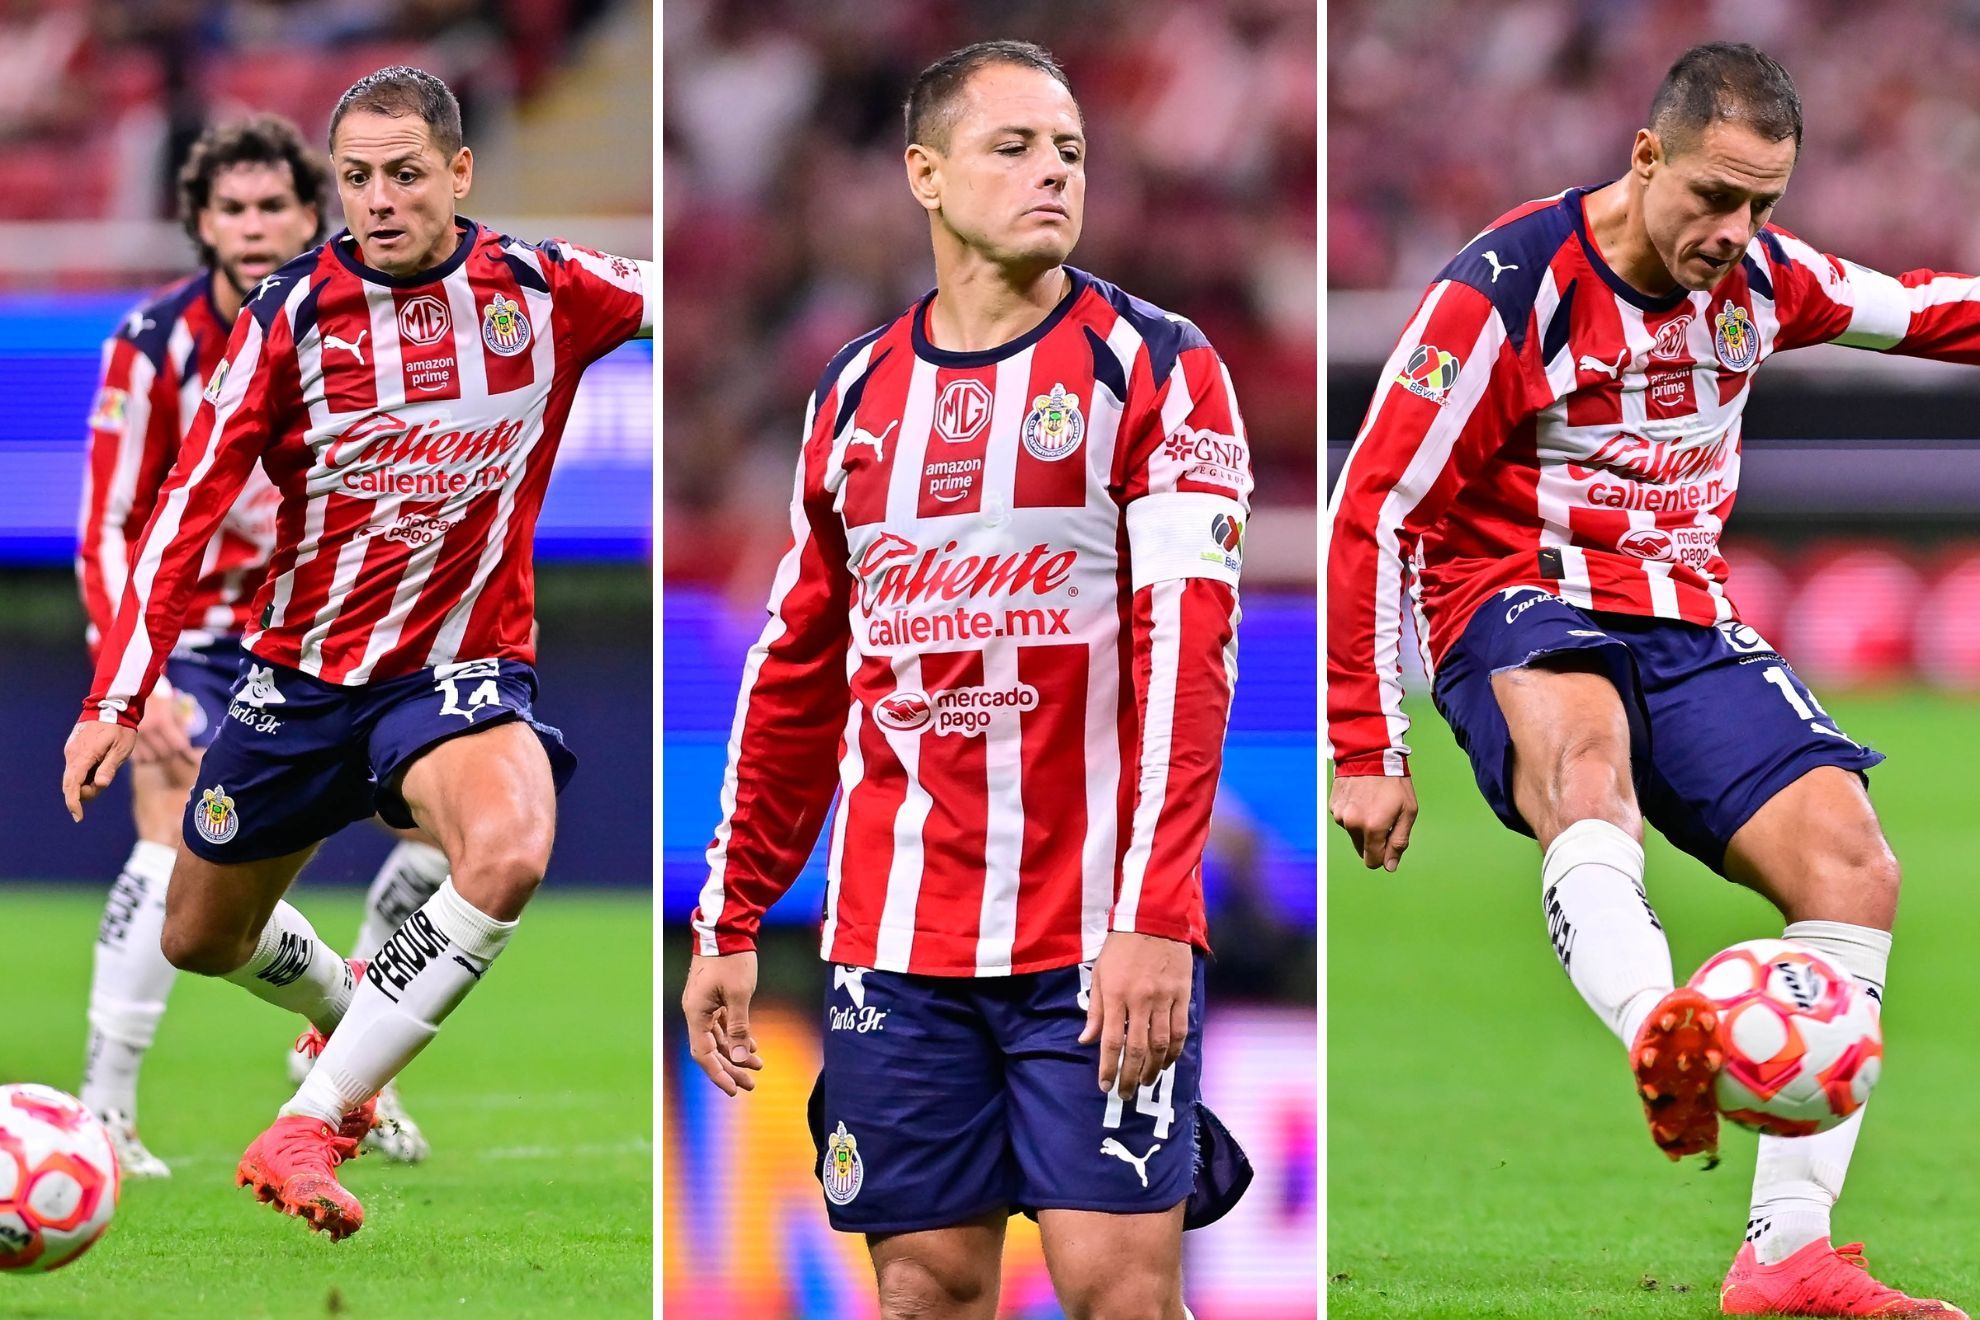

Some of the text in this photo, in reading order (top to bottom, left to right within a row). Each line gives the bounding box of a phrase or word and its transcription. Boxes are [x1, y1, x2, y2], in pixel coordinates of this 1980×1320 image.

[405, 356, 455, 372] amazon
[411, 369, 450, 387] prime
[1409, 382, 1437, 400] BBVA
[1652, 380, 1686, 400] prime
[941, 387, 985, 435] MG
[1194, 437, 1242, 470] GNP
[925, 458, 982, 475] amazon
[929, 475, 973, 495] prime
[390, 526, 433, 544] pago
[1680, 547, 1709, 565] pago
[857, 531, 1078, 618] Caliente
[868, 608, 1072, 646] caliente.mx
[937, 687, 1033, 707] mercado
[254, 714, 281, 735] Jr.
[940, 711, 991, 731] pago
[856, 1005, 887, 1034] Jr.
